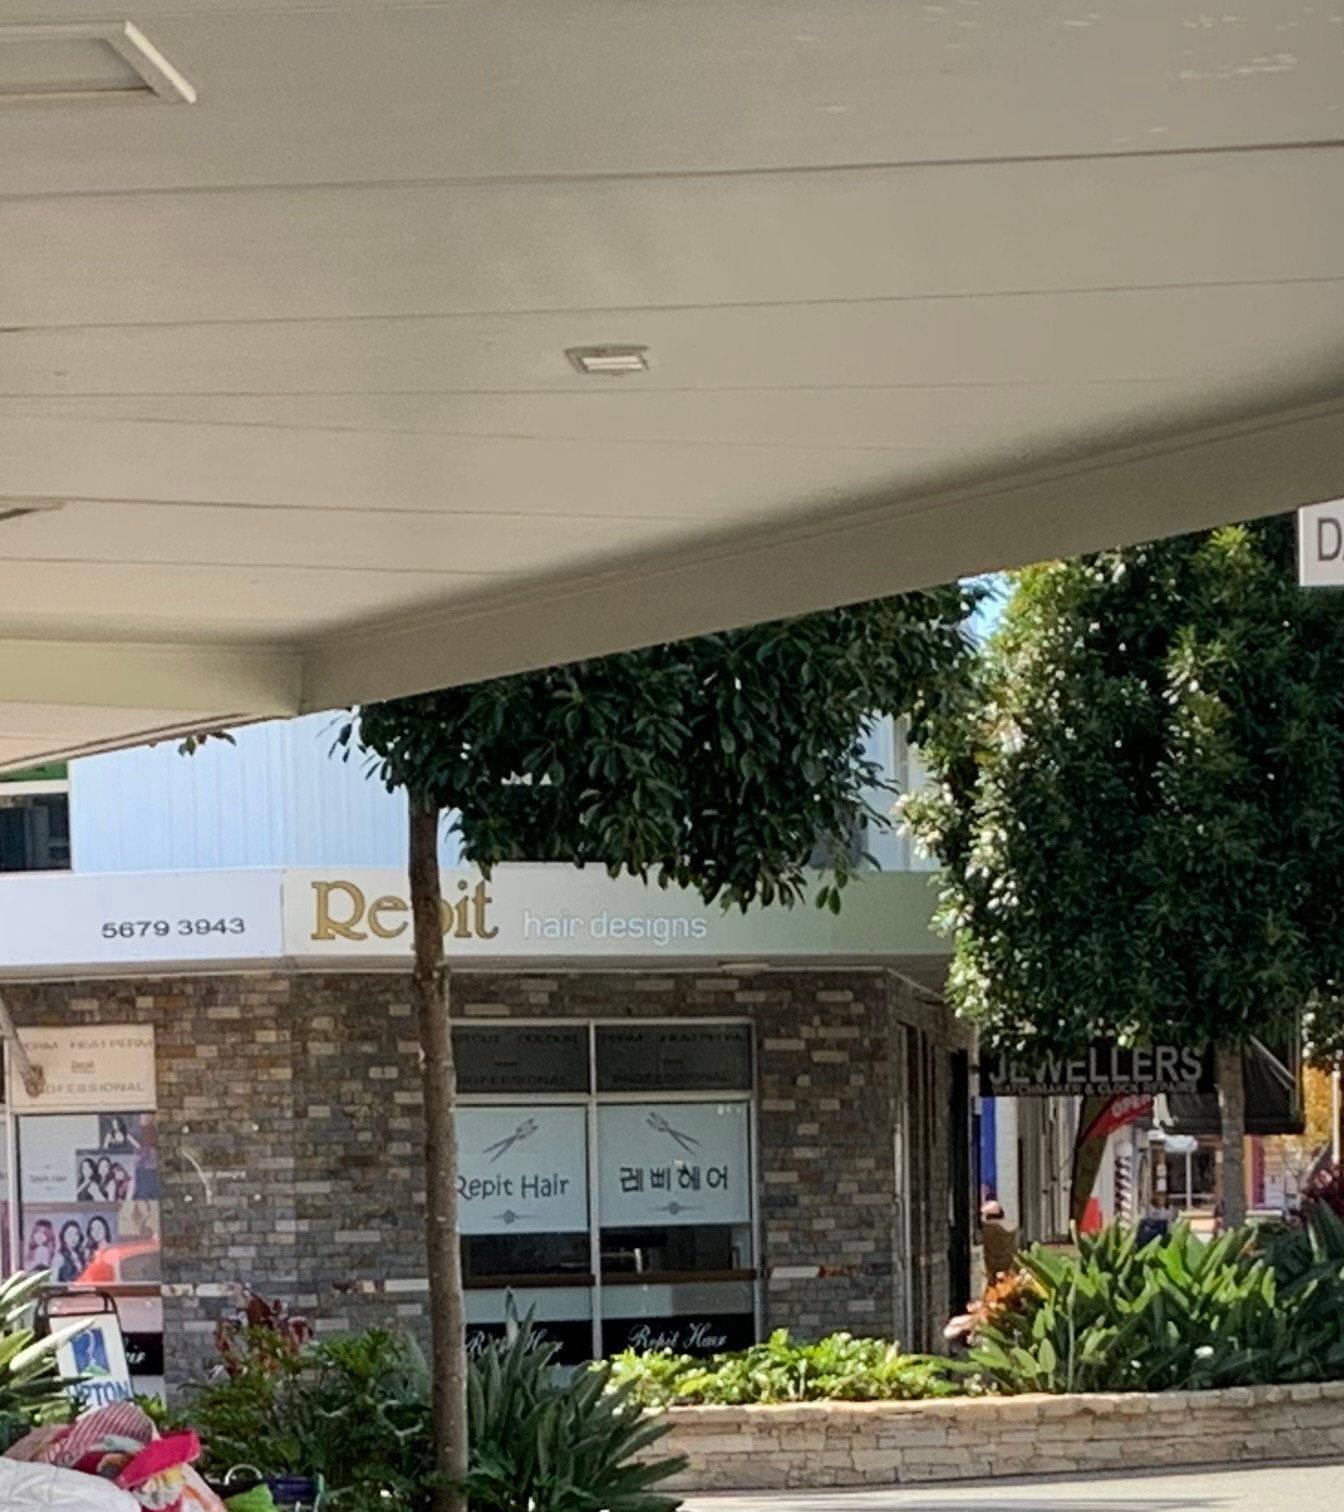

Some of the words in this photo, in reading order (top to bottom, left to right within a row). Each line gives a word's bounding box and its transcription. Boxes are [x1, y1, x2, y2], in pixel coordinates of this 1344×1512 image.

[101, 920, 171, 939] 5679
[177, 917, 246, 936] 3943
[523, 908, 584, 938] hair
[590, 908, 708, 946] designs
[456, 1174, 513, 1200] Repit
[521, 1172, 570, 1199] Hair
